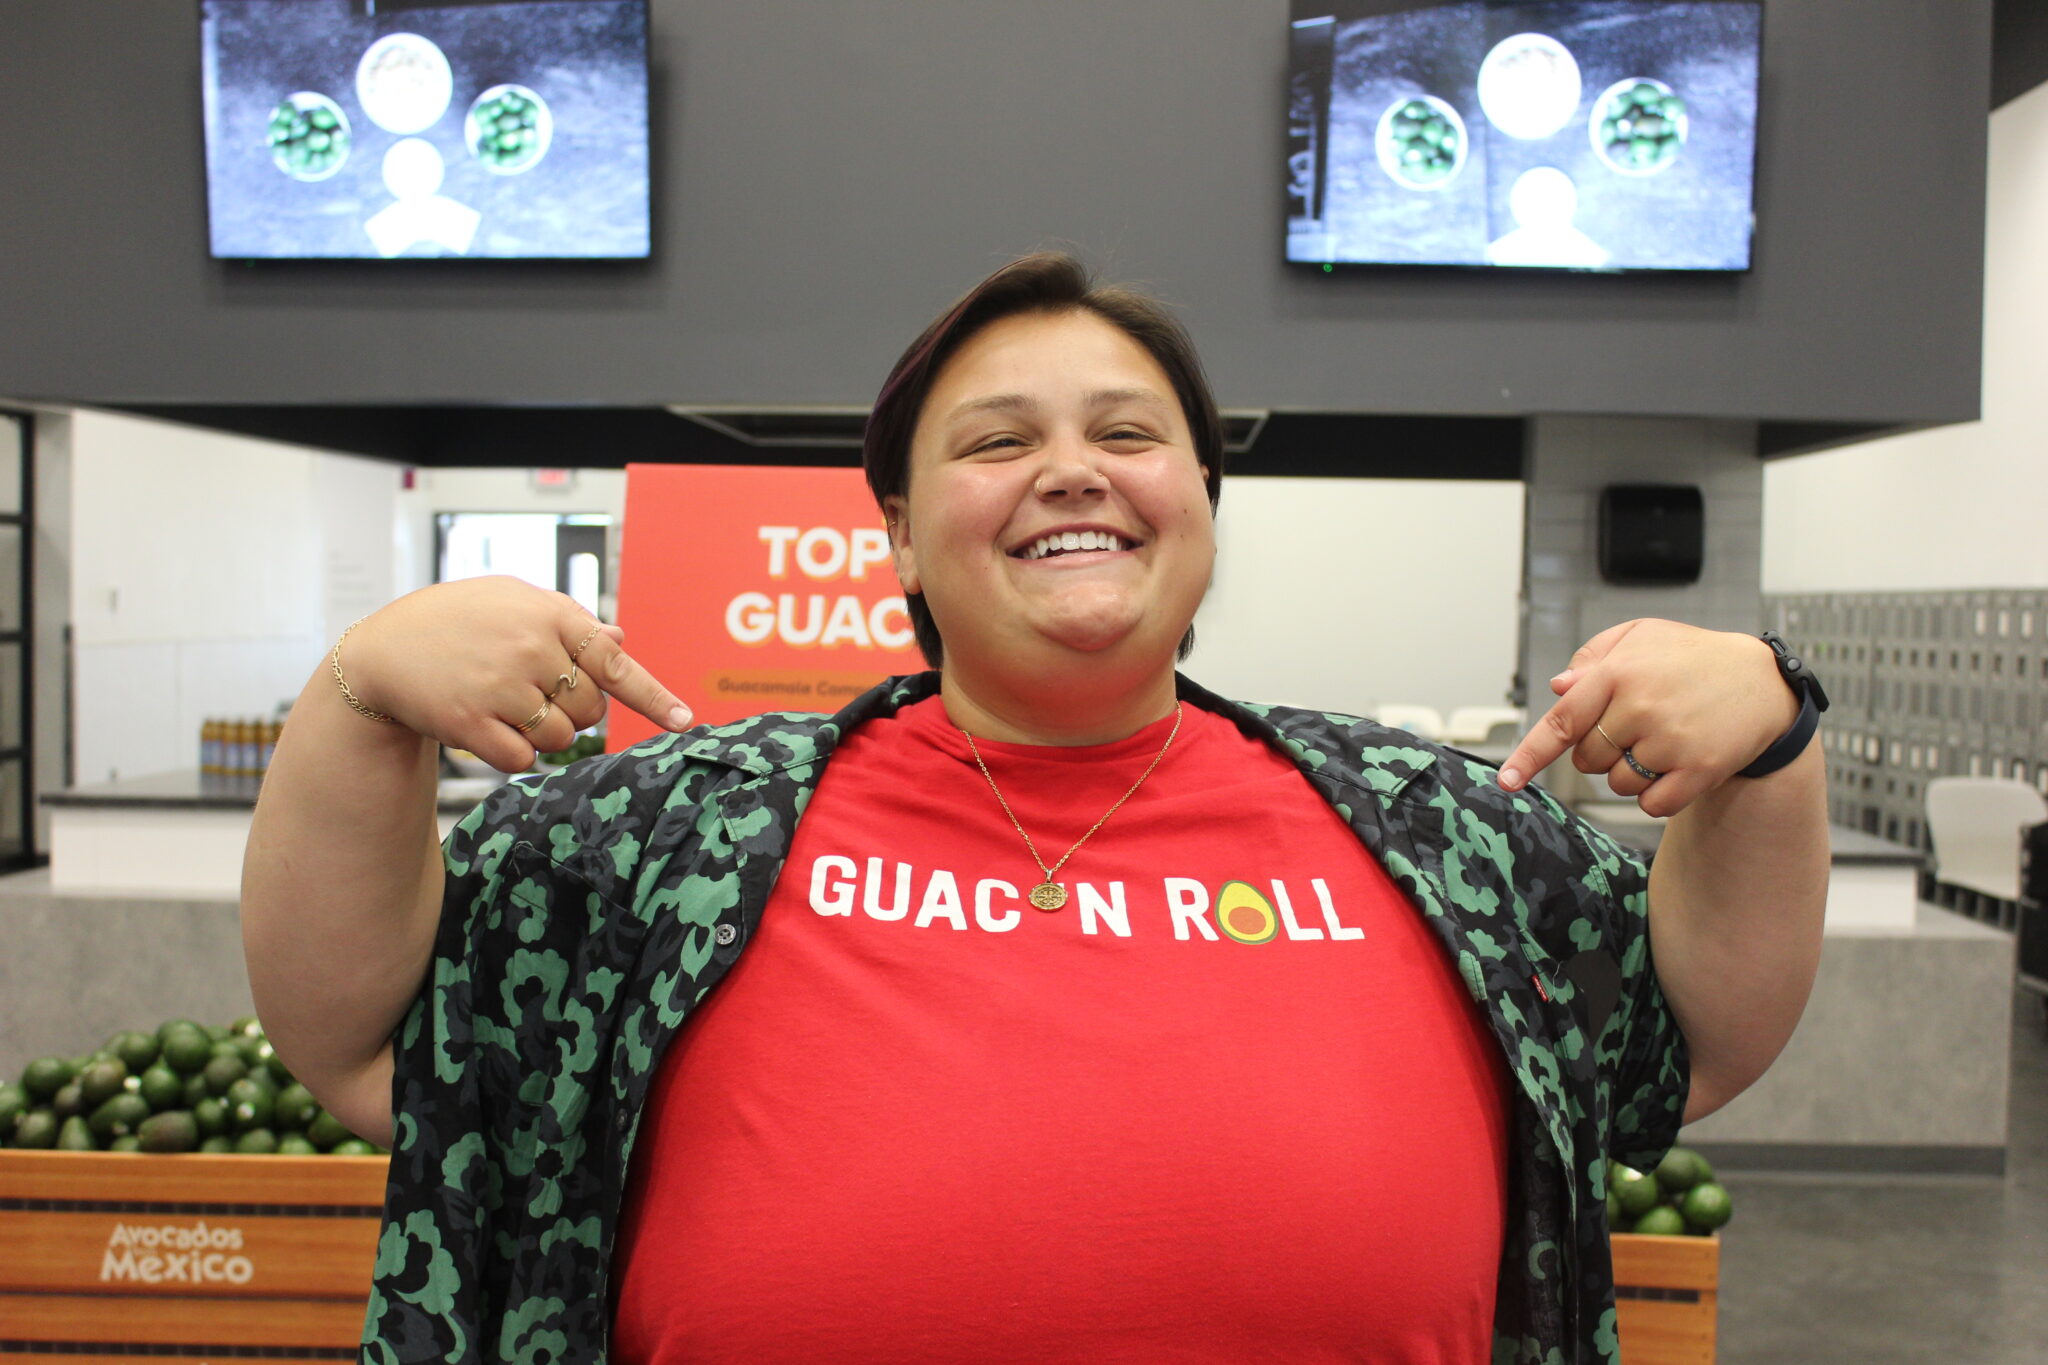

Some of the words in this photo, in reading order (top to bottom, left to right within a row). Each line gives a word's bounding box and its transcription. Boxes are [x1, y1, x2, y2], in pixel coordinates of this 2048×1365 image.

[758, 525, 891, 579] TOP
[725, 591, 916, 649] GUAC
[809, 855, 1022, 933] GUAC
[109, 1221, 244, 1250] Avocados
[100, 1248, 254, 1284] Mexico
